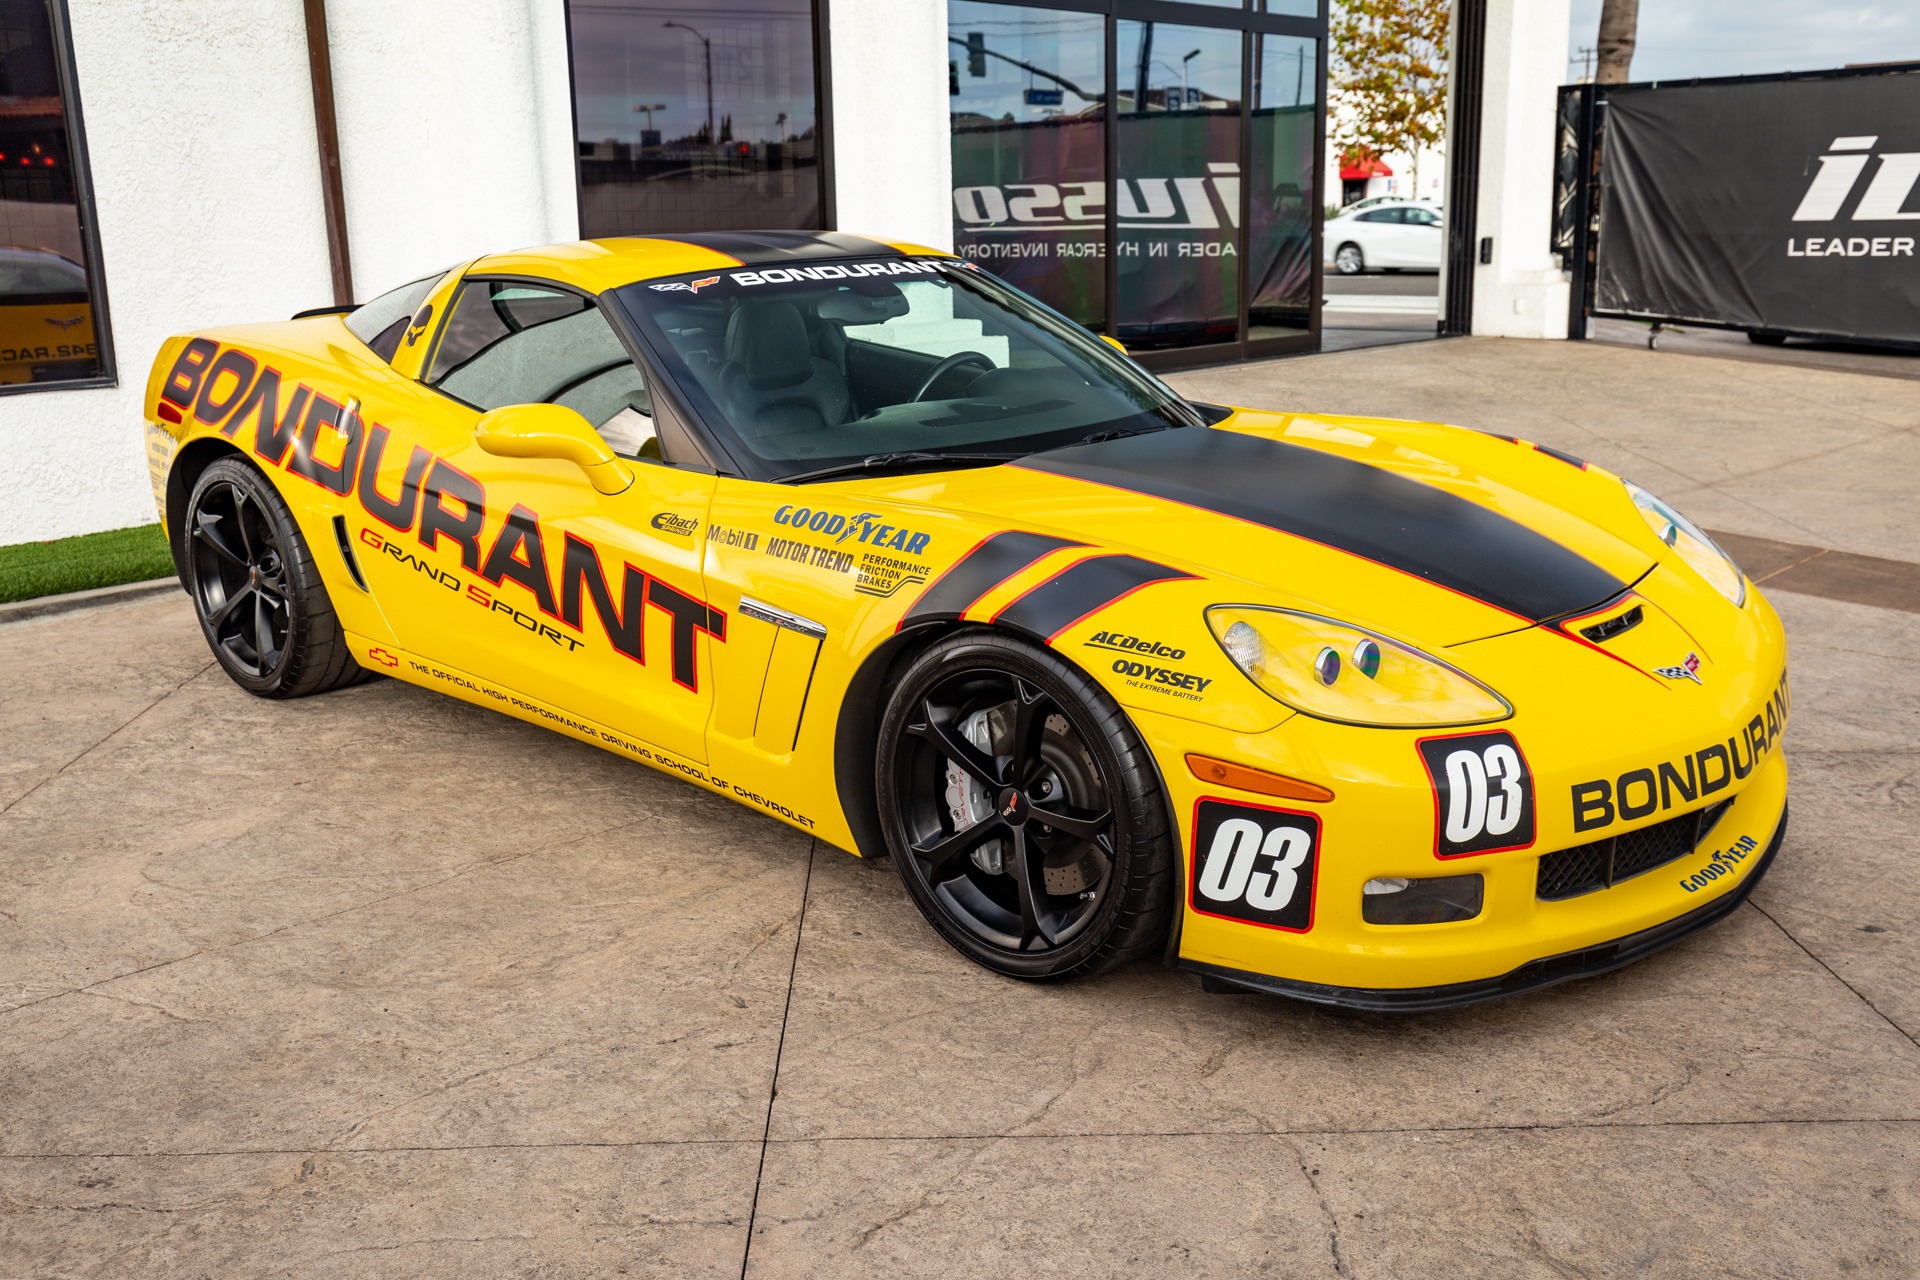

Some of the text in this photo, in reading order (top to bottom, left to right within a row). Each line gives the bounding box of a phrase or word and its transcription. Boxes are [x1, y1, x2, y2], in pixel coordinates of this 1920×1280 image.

[1787, 237, 1914, 257] LEADER
[730, 260, 948, 287] BONDURANT
[161, 337, 727, 694] BONDURANT
[651, 512, 699, 530] Eibach
[661, 524, 692, 536] SPRINGS
[706, 525, 744, 548] Mobil
[765, 537, 855, 574] MOTOR TREND
[862, 553, 932, 576] PERFORMANCE
[857, 574, 892, 589] BRAKES
[859, 564, 901, 580] FRICTION
[360, 528, 584, 652] GRAND SPORT
[1088, 630, 1186, 660] ACDelco
[1112, 659, 1212, 692] ODYSSEY
[1125, 679, 1204, 702] THE EXTREME BATTERY
[408, 661, 816, 830] THE OFFICIAL HIGH PERFORMANCE DRIVING SCHOOL OF CHEVROLET
[1571, 664, 1792, 834] BONDURANT
[1444, 744, 1523, 843] 03
[1198, 818, 1311, 911] 03
[1679, 834, 1759, 893] GOODYEAR
